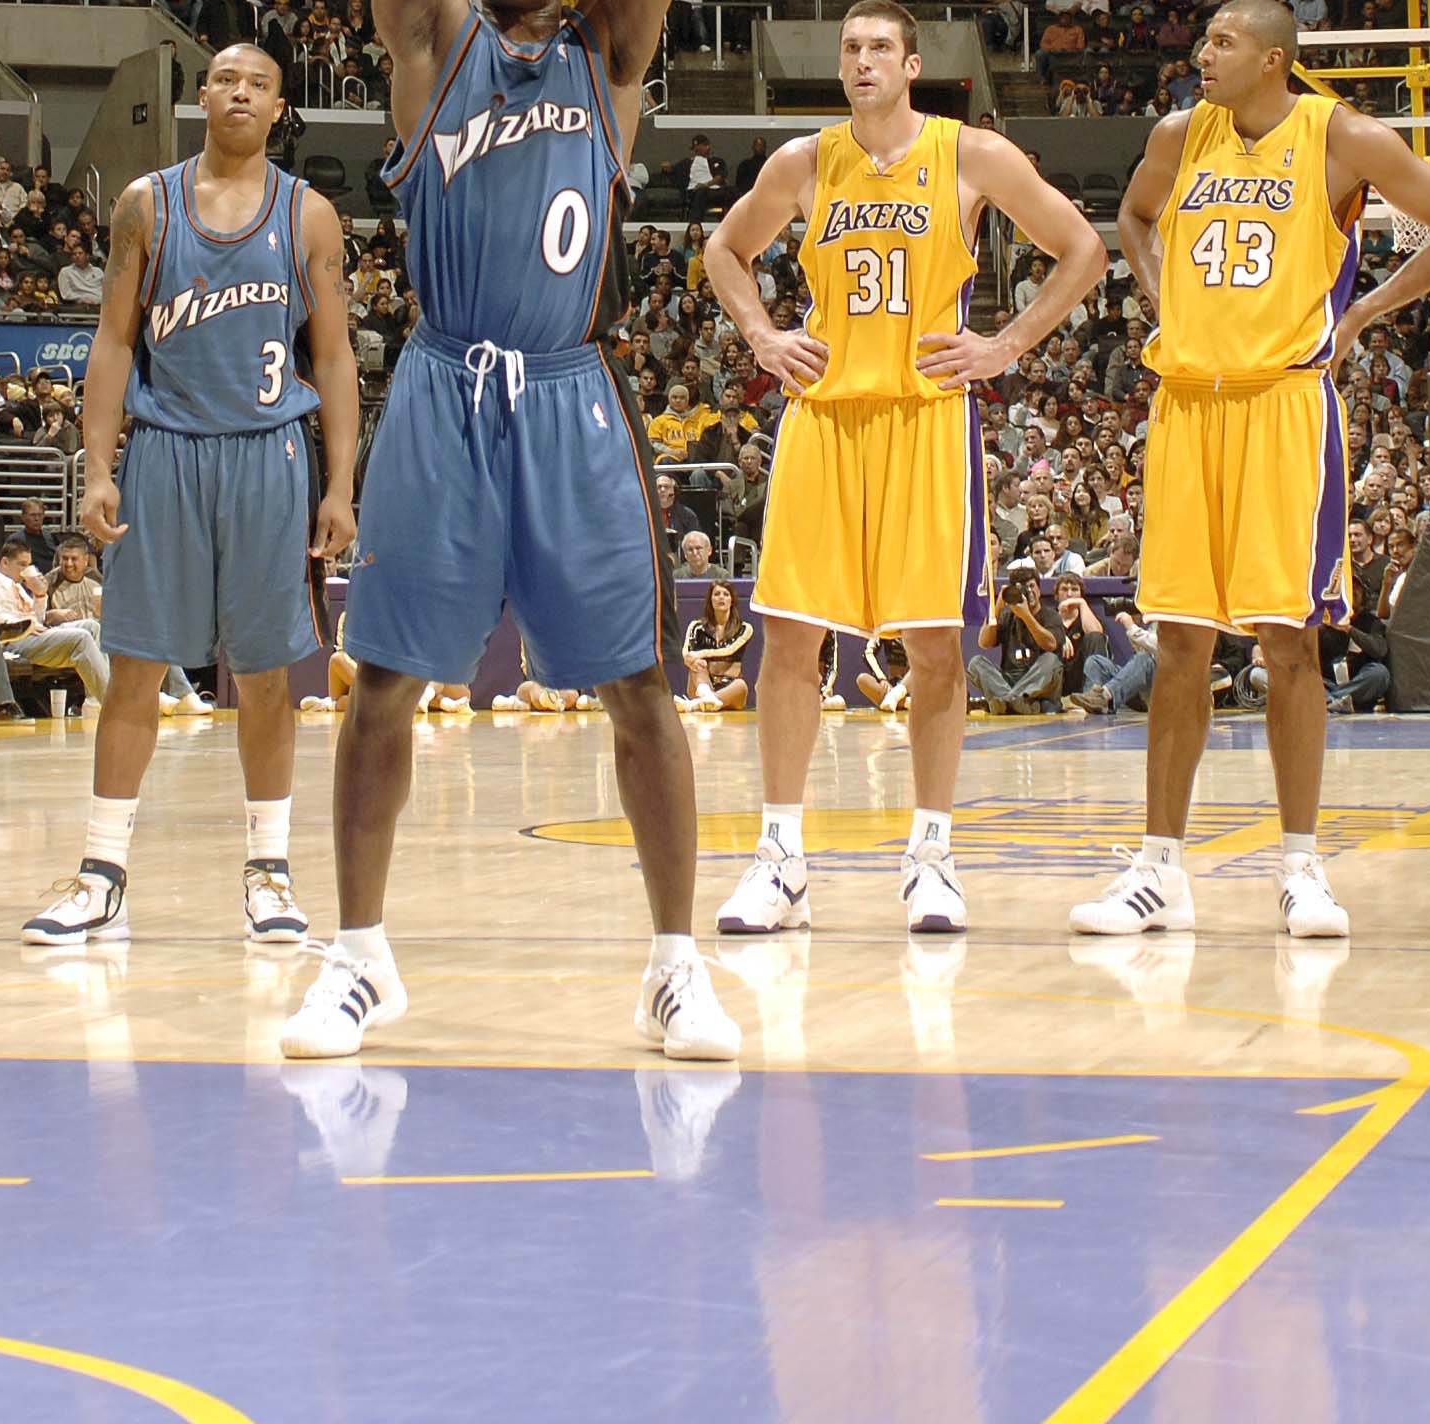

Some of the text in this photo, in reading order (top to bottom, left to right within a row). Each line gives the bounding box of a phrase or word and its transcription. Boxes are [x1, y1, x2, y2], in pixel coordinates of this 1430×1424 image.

[816, 200, 929, 247] LAKERS
[1178, 172, 1294, 212] LAKERS
[541, 188, 590, 276] 0
[1191, 219, 1275, 288] 43
[845, 247, 909, 315] 31
[151, 282, 288, 345] WIZARDS
[41, 343, 89, 361] SBC
[258, 339, 287, 405] 3
